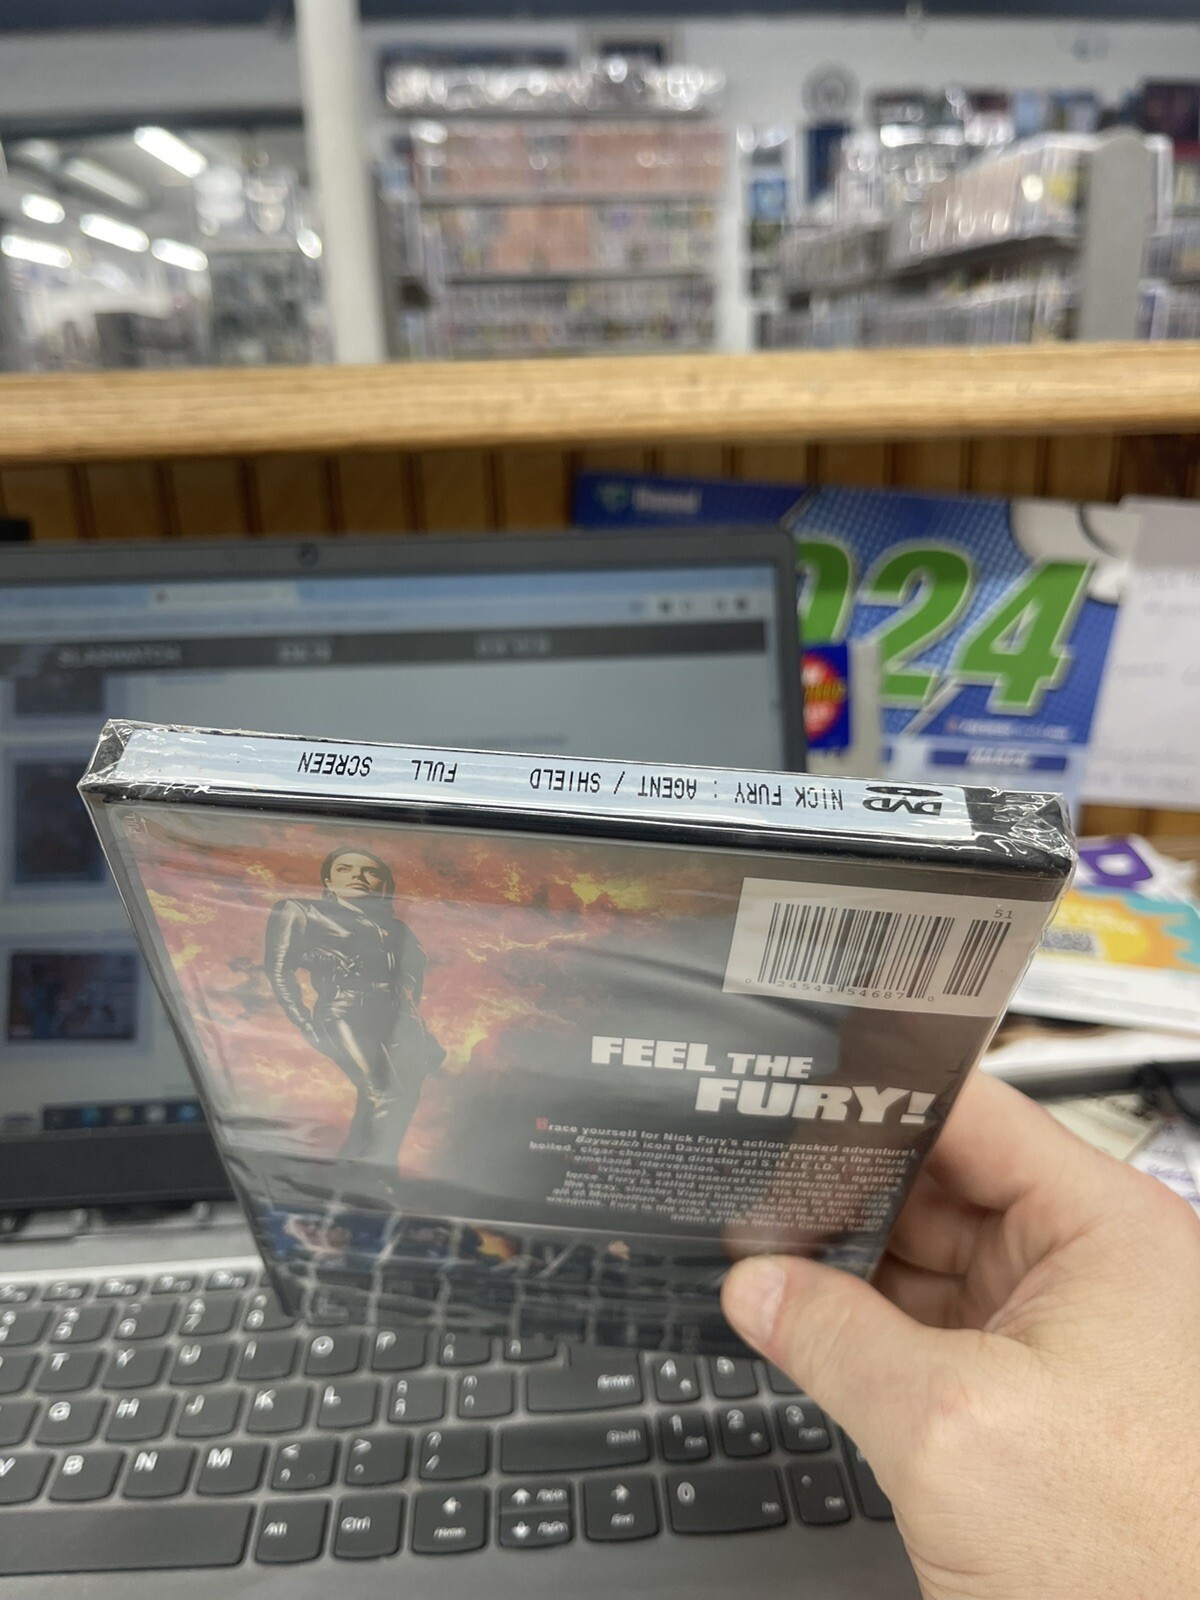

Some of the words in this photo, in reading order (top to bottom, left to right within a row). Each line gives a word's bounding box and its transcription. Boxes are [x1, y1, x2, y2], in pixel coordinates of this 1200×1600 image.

[298, 752, 373, 777] SCREEN
[411, 759, 458, 783] FULL
[529, 768, 601, 793] SHIELD
[613, 771, 626, 795] /
[638, 776, 697, 800] AGENT
[733, 784, 783, 806] FURY
[795, 789, 844, 811] NICK
[993, 909, 1014, 920] 51
[591, 1035, 716, 1072] FEEL
[727, 1052, 814, 1079] THE
[695, 1077, 937, 1124] FURY!
[536, 1119, 577, 1133] Brace
[582, 1126, 637, 1138] yourself
[641, 1131, 659, 1139] for
[663, 1132, 693, 1142] Nick
[697, 1134, 738, 1147] Fury's
[742, 1138, 838, 1153] action-packed
[575, 1135, 639, 1148] Baywatch
[643, 1141, 670, 1150] icon
[675, 1143, 712, 1153] David
[717, 1146, 788, 1158] Hasselhoff
[793, 1152, 825, 1161] stars
[850, 1154, 869, 1163] the
[743, 1157, 755, 1165] of
[135, 1451, 158, 1472] N
[207, 1447, 233, 1469] M
